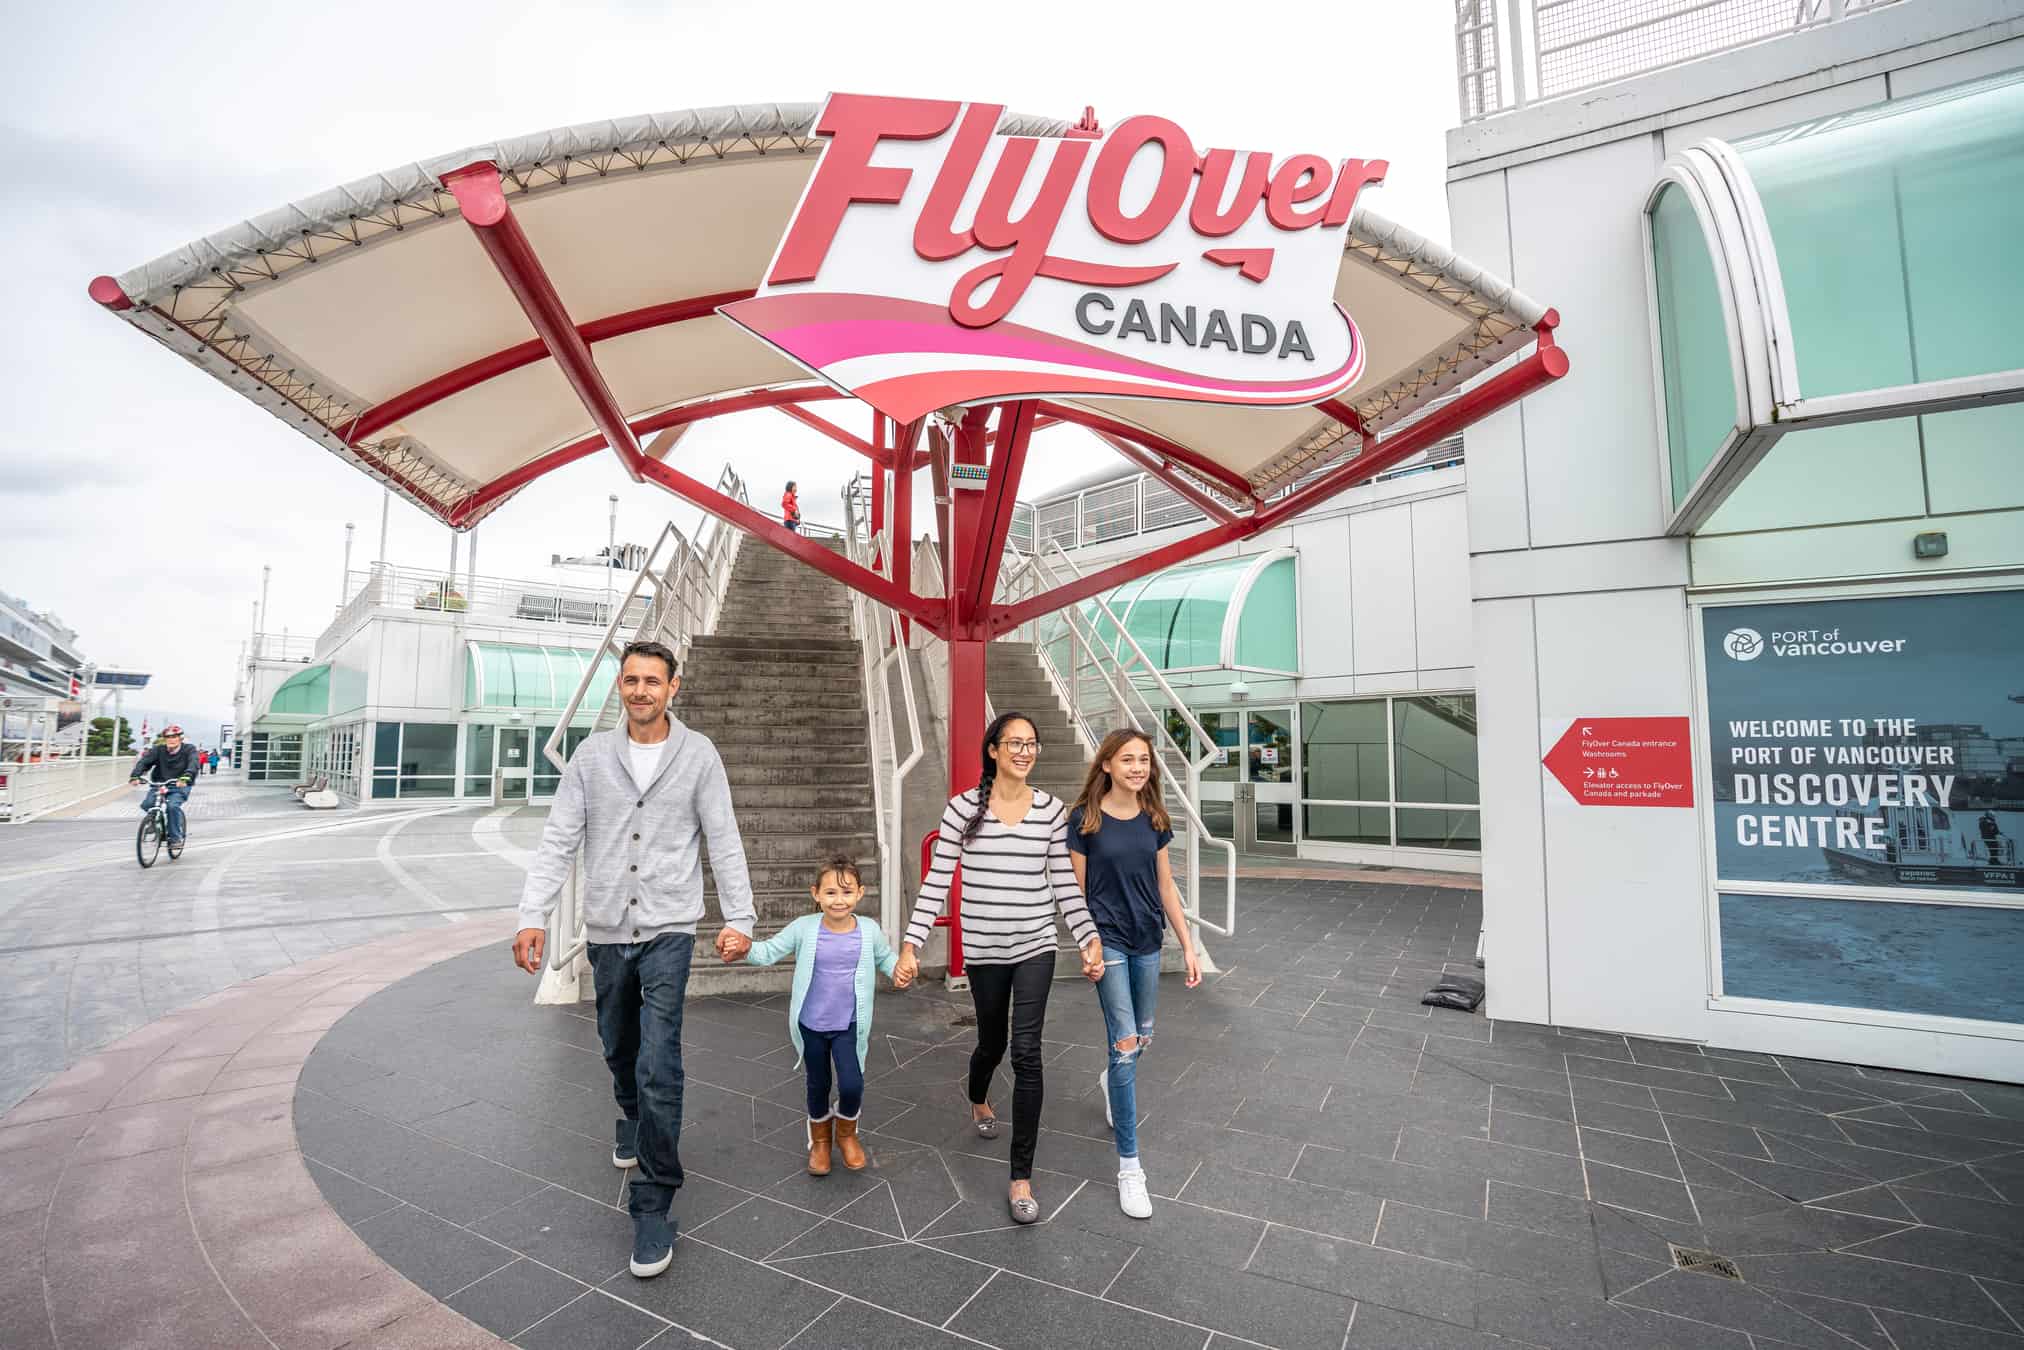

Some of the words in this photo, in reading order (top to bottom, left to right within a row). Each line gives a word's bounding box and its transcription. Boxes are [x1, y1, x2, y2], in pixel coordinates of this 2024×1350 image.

[767, 92, 1390, 329] FlyOver
[1075, 291, 1315, 361] CANADA
[1771, 630, 1819, 643] PORT
[1822, 628, 1840, 641] of
[1773, 638, 1906, 657] vancouver
[1729, 719, 1833, 738] WELCOME
[1839, 718, 1867, 737] TO
[1874, 718, 1916, 737] THE
[1582, 740, 1610, 748] FlyOver
[1731, 747, 1783, 765] PORT
[1790, 747, 1817, 765] OF
[1823, 746, 1955, 766] VANCOUVER
[1583, 781, 1614, 789] Elevator
[1653, 782, 1683, 791] FlyOver
[1583, 789, 1612, 797] Canada
[1629, 790, 1661, 799] parkade
[1734, 773, 1955, 808] DISCOVERY
[1736, 814, 1888, 850] CENTRE
